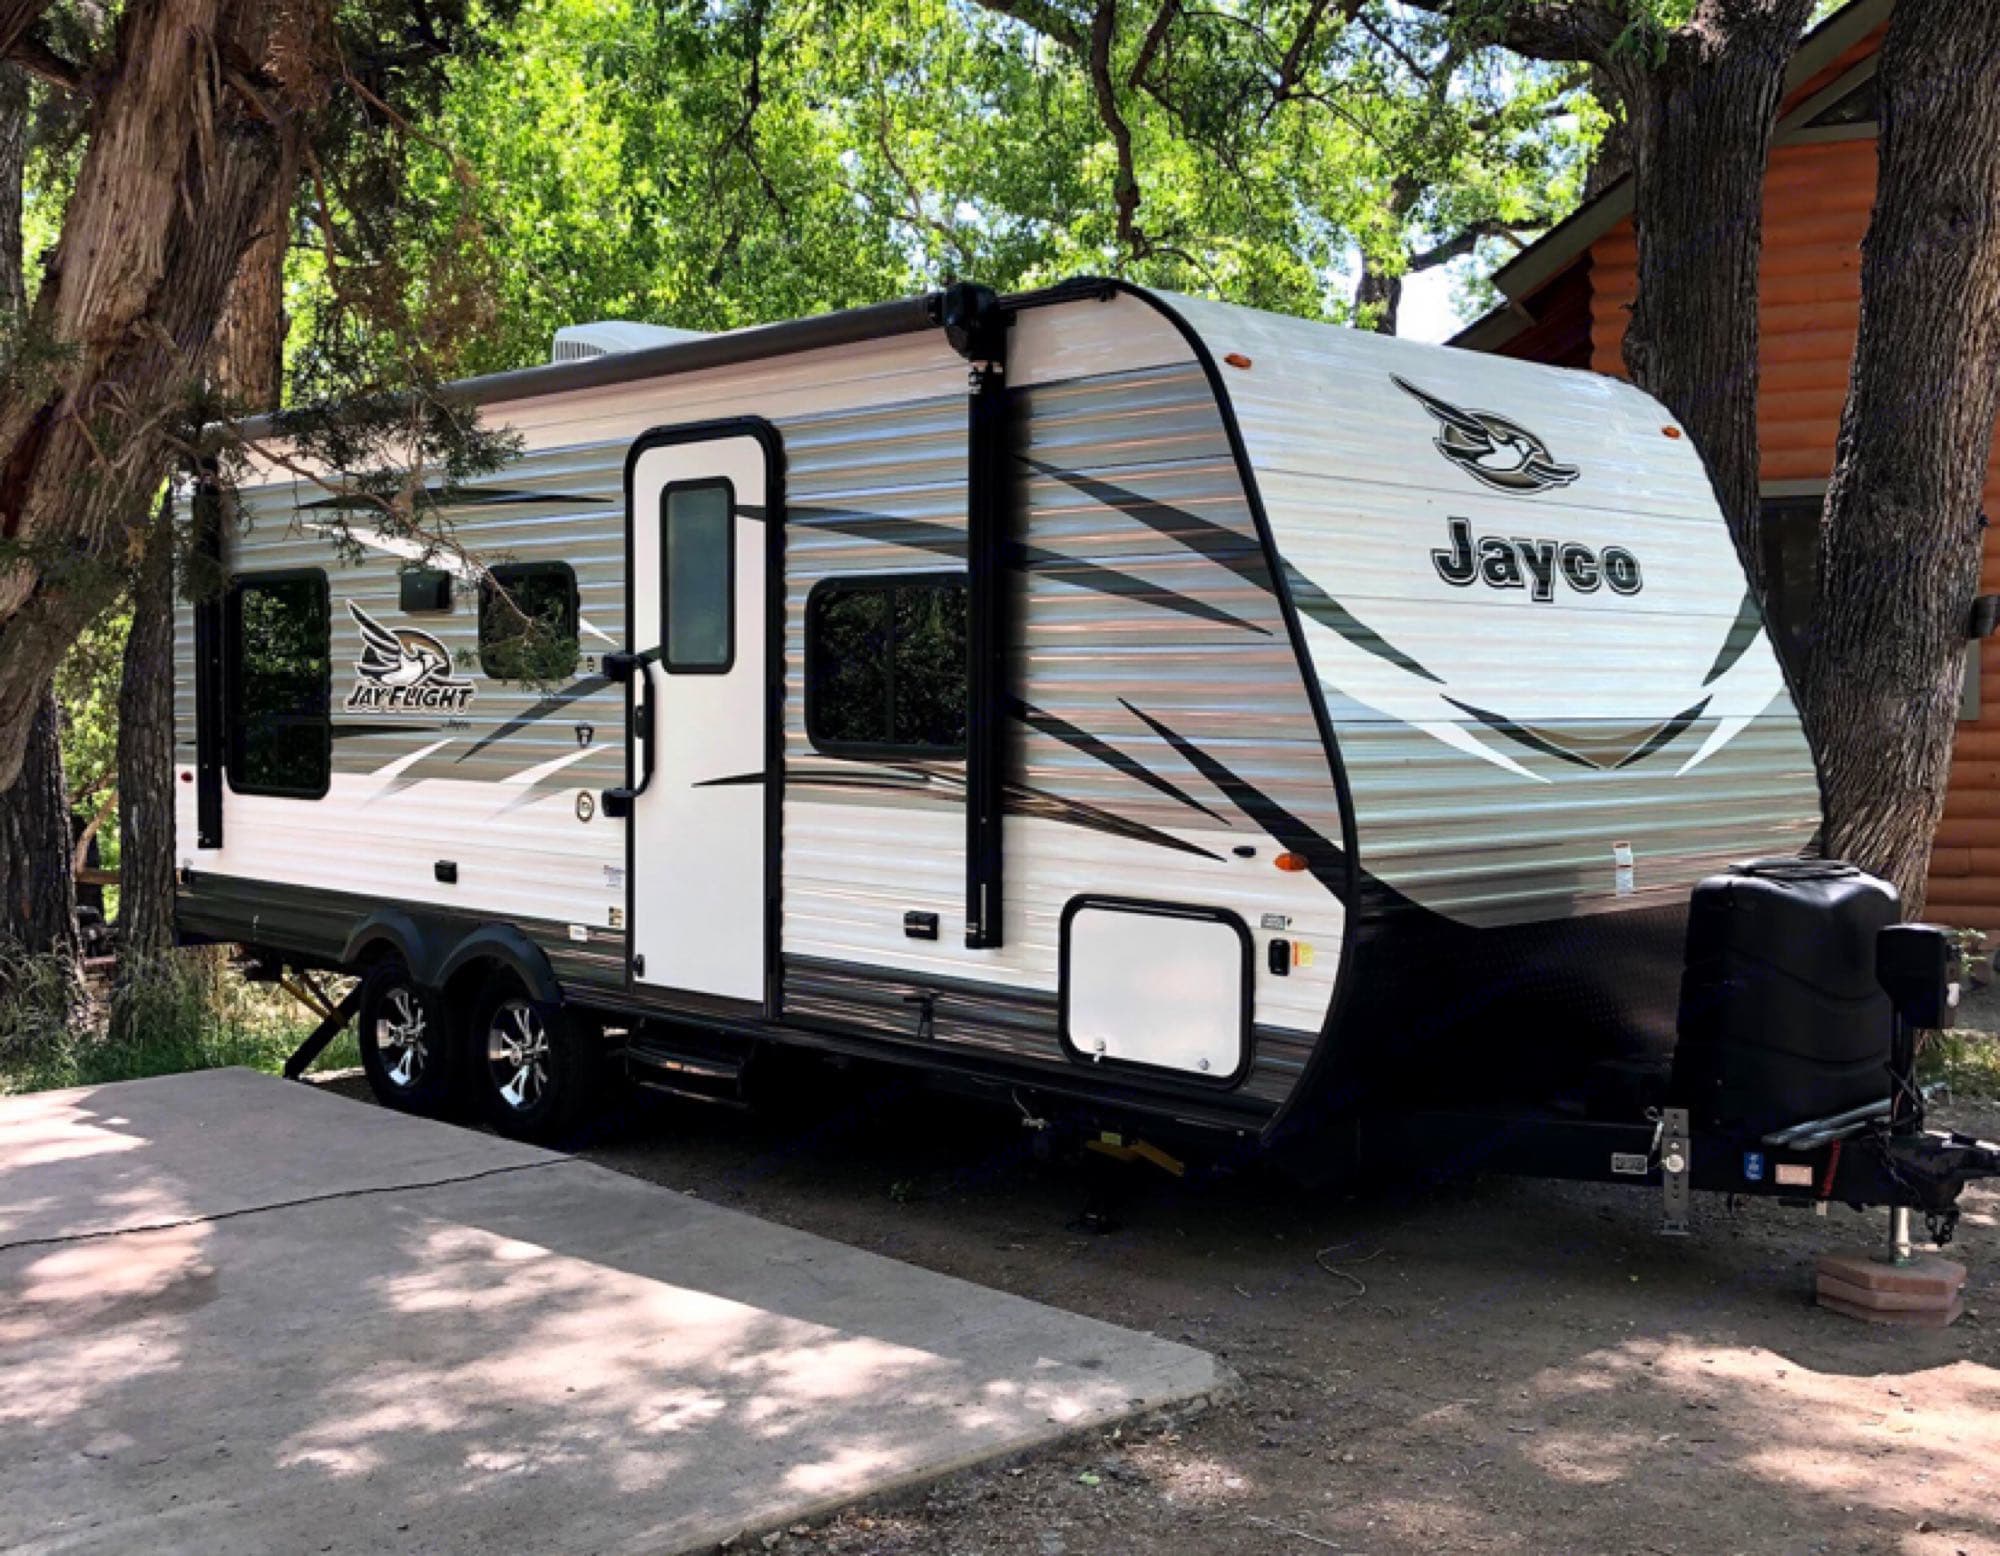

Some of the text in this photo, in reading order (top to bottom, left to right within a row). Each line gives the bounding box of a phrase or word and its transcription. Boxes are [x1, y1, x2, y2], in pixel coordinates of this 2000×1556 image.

[1430, 517, 1643, 603] Jayco
[346, 684, 475, 709] JAY FLIGHT
